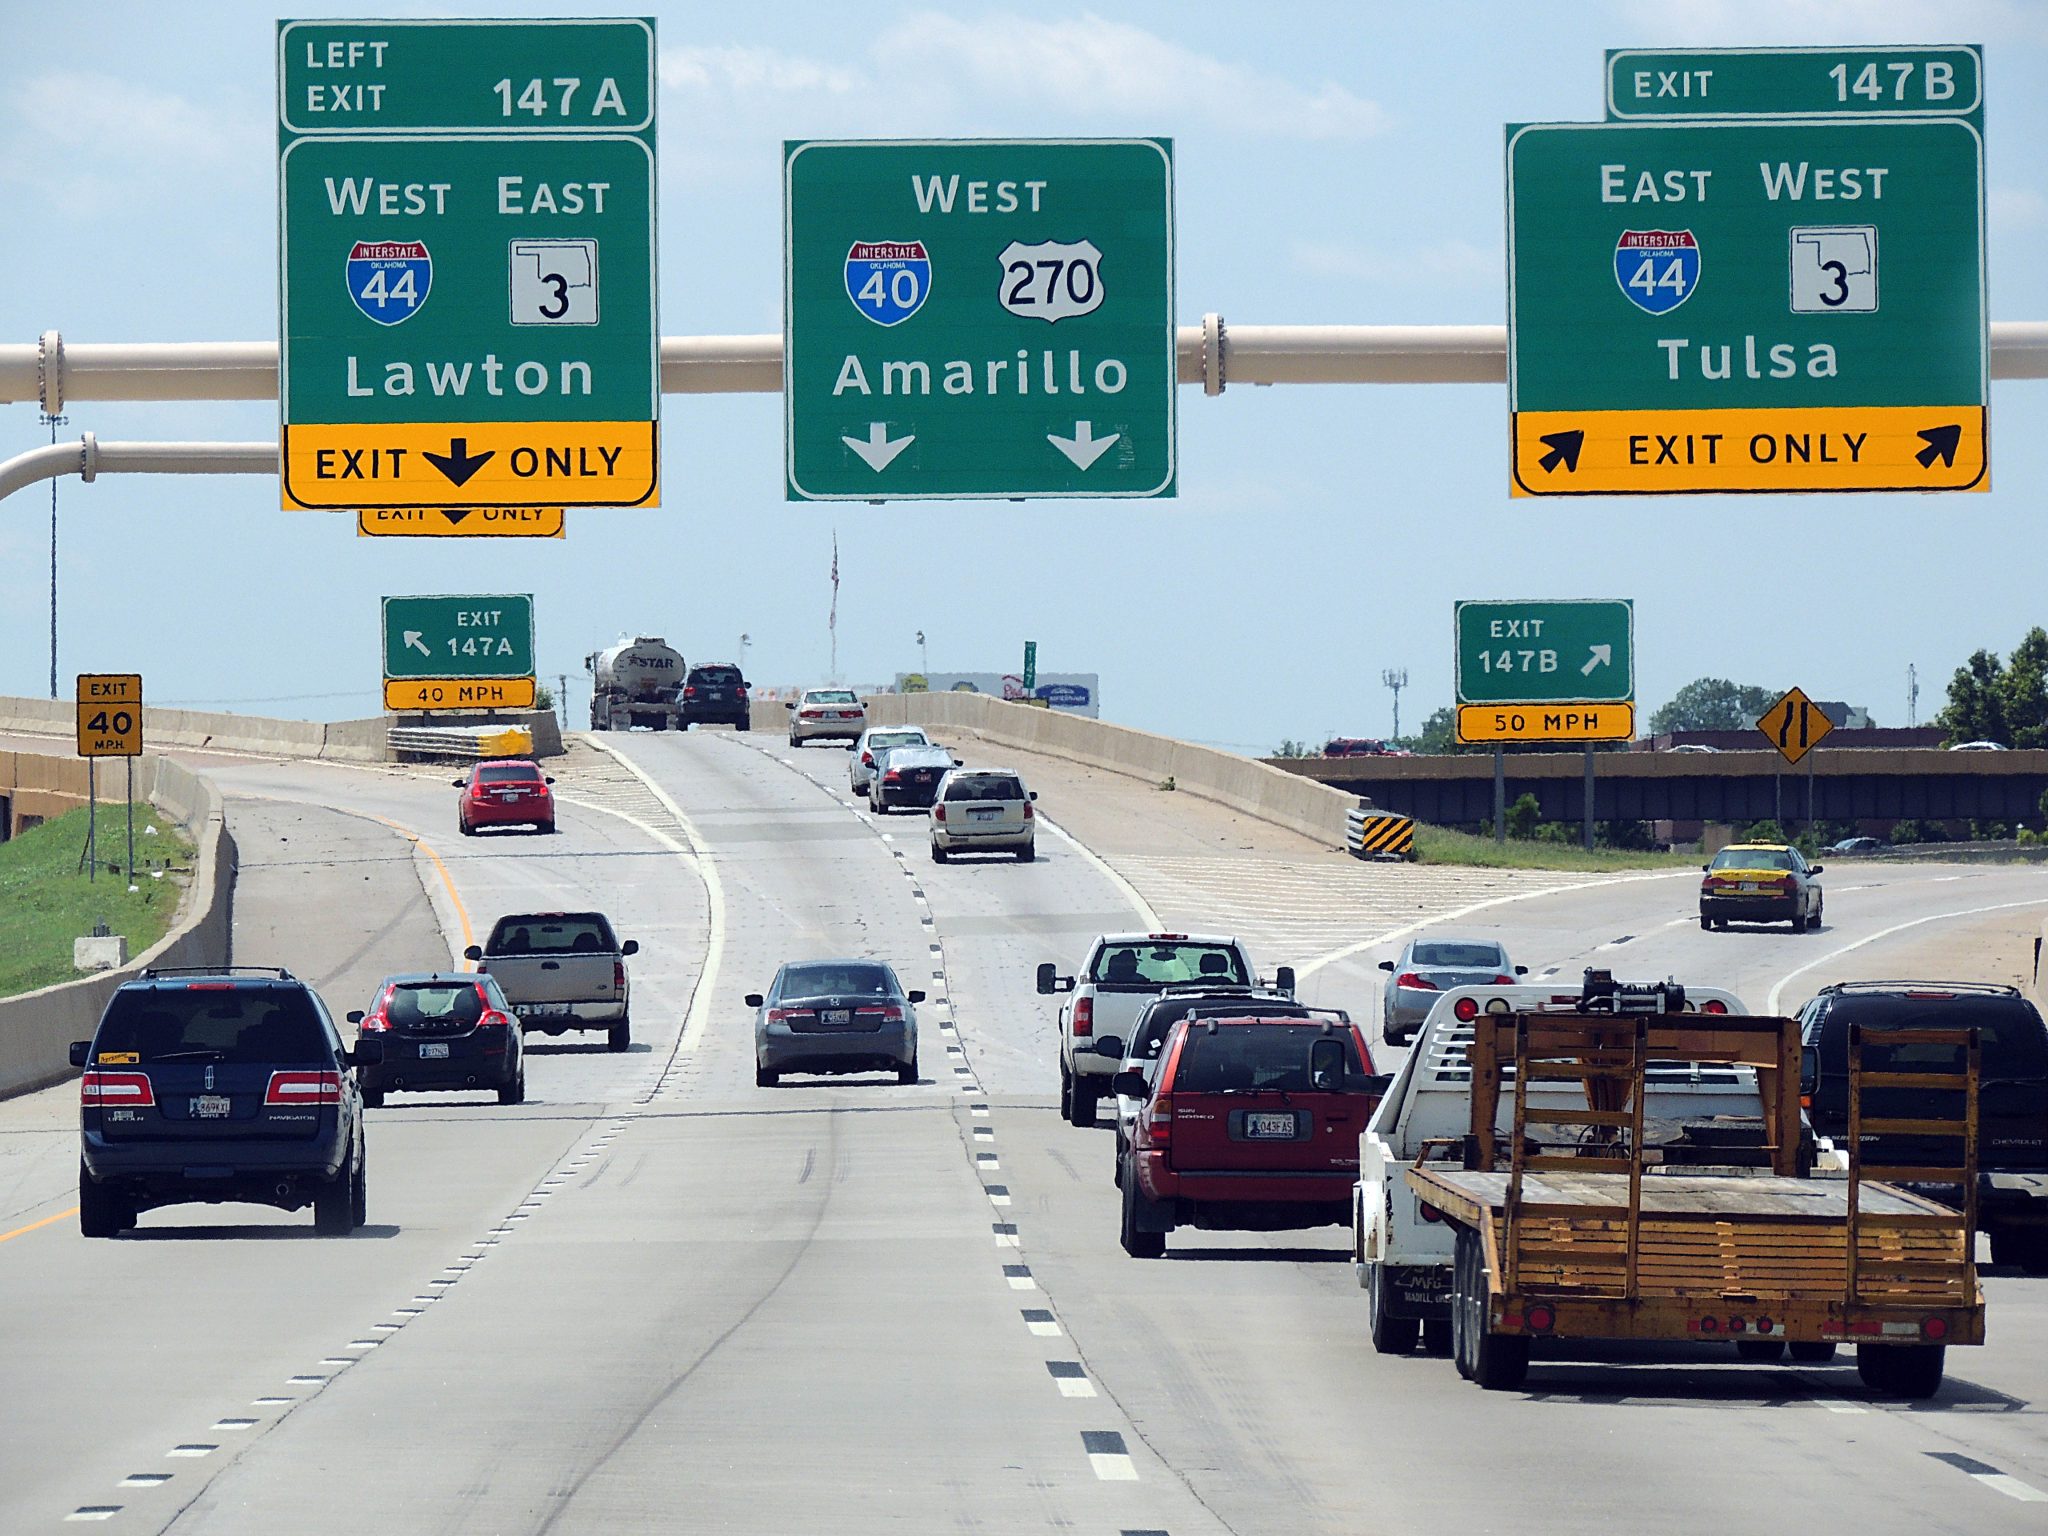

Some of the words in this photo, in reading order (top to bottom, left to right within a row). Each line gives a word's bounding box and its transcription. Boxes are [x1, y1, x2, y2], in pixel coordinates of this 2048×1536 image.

[306, 41, 389, 68] LEFT
[1634, 70, 1713, 98] EXIT
[307, 84, 387, 112] EXIT
[359, 245, 418, 259] INTERSTATE
[858, 246, 918, 259] INTERSTATE
[1627, 234, 1687, 248] INTERSTATE
[370, 261, 407, 269] OKLAHOMA
[1629, 258, 1686, 297] 44
[360, 270, 418, 308] 44
[857, 269, 919, 309] 40
[1008, 259, 1095, 305] 270
[1819, 260, 1849, 306] 3
[538, 273, 570, 319] 3
[1657, 335, 1838, 380] Tulsa
[347, 354, 592, 397] Lawton
[832, 350, 1128, 396] Amarillo
[1629, 434, 1723, 465] EXIT
[1749, 432, 1868, 464] ONLY
[316, 449, 408, 480] EXIT
[510, 446, 623, 478] ONLY
[457, 611, 501, 627] EXIT
[1490, 619, 1545, 638] EXIT
[447, 637, 514, 656] 147A
[1478, 649, 1558, 674] 147B
[91, 683, 127, 696] EXIT
[418, 687, 444, 702] 40
[459, 686, 503, 701] MPH
[87, 711, 132, 735] 40
[1495, 714, 1525, 731] 50
[1544, 713, 1598, 731] MPH
